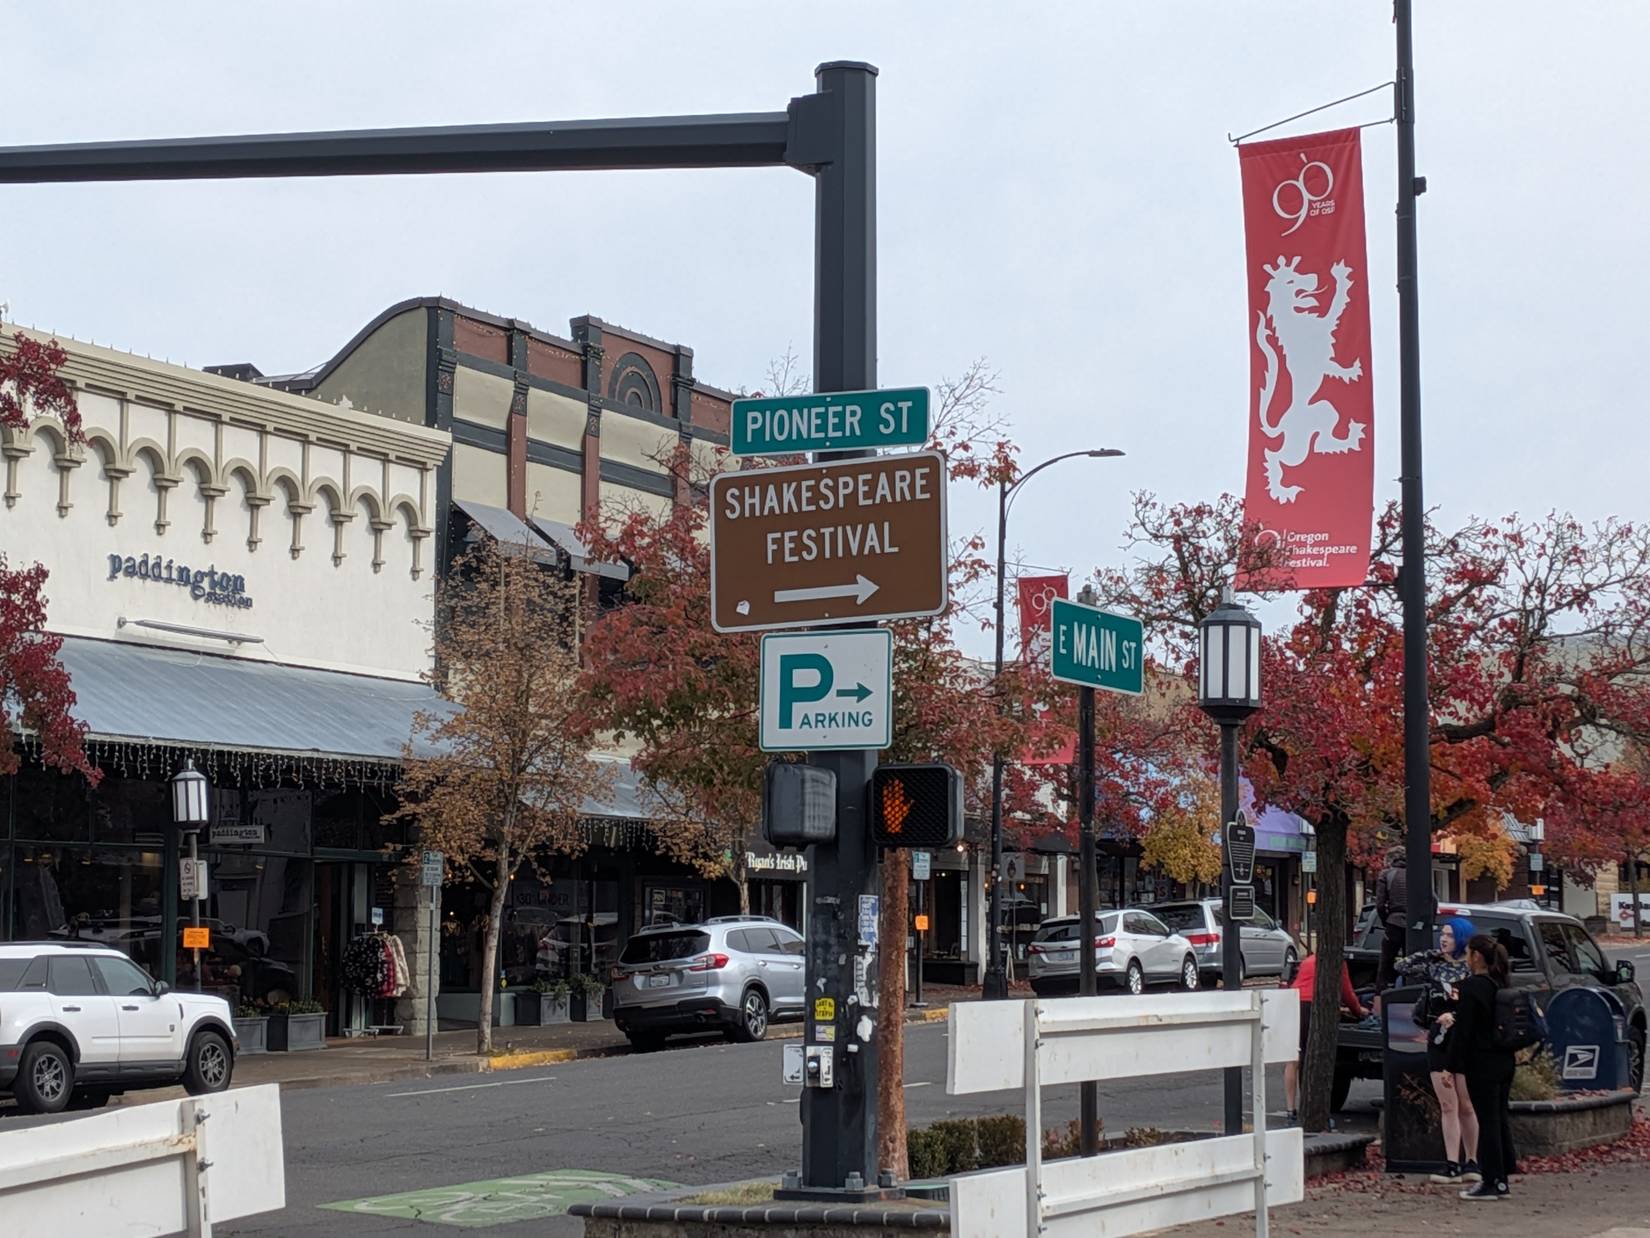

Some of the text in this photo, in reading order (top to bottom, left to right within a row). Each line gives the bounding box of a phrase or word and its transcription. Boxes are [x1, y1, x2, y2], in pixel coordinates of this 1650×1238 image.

[746, 401, 913, 442] PIONEER ST
[725, 467, 930, 519] SHAKESPEARE
[766, 521, 899, 564] FESTIVAL
[1287, 532, 1329, 543] Oregon
[107, 553, 245, 600] paddington
[204, 591, 253, 609] station
[1060, 621, 1136, 672] E MAIN ST
[745, 852, 808, 874] Ryan's Irish Pu
